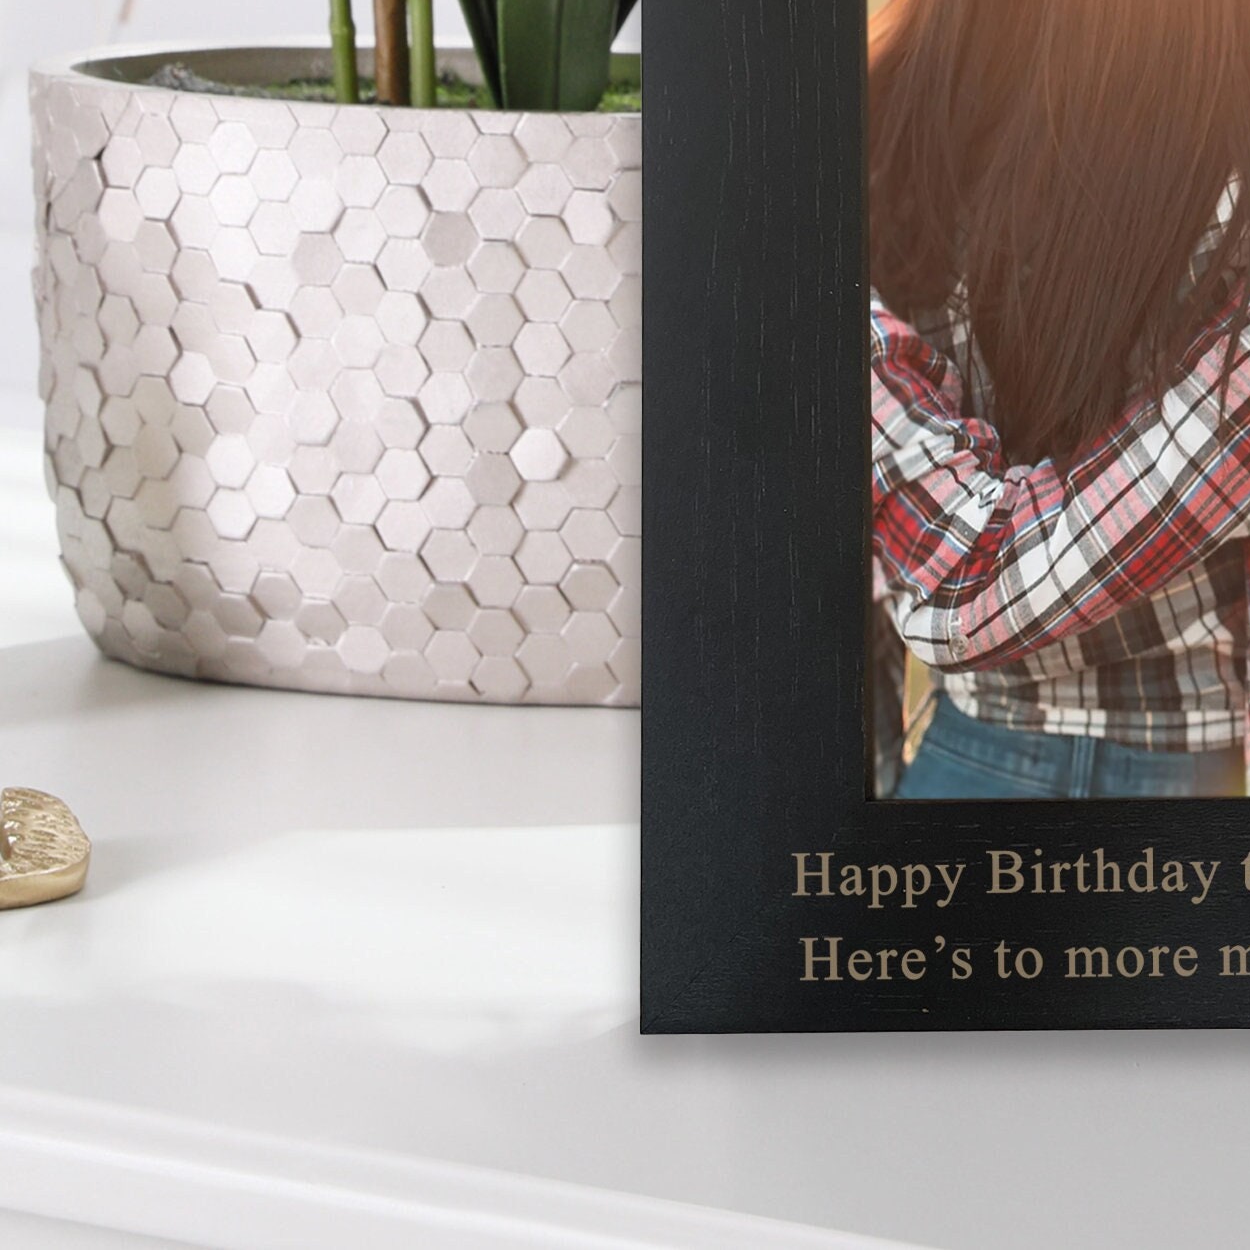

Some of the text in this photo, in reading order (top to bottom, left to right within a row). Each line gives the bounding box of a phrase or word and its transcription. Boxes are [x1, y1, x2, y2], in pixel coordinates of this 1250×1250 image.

[791, 852, 967, 909] Happy
[985, 846, 1222, 905] Birthday
[993, 939, 1044, 979] to
[1064, 945, 1199, 978] more
